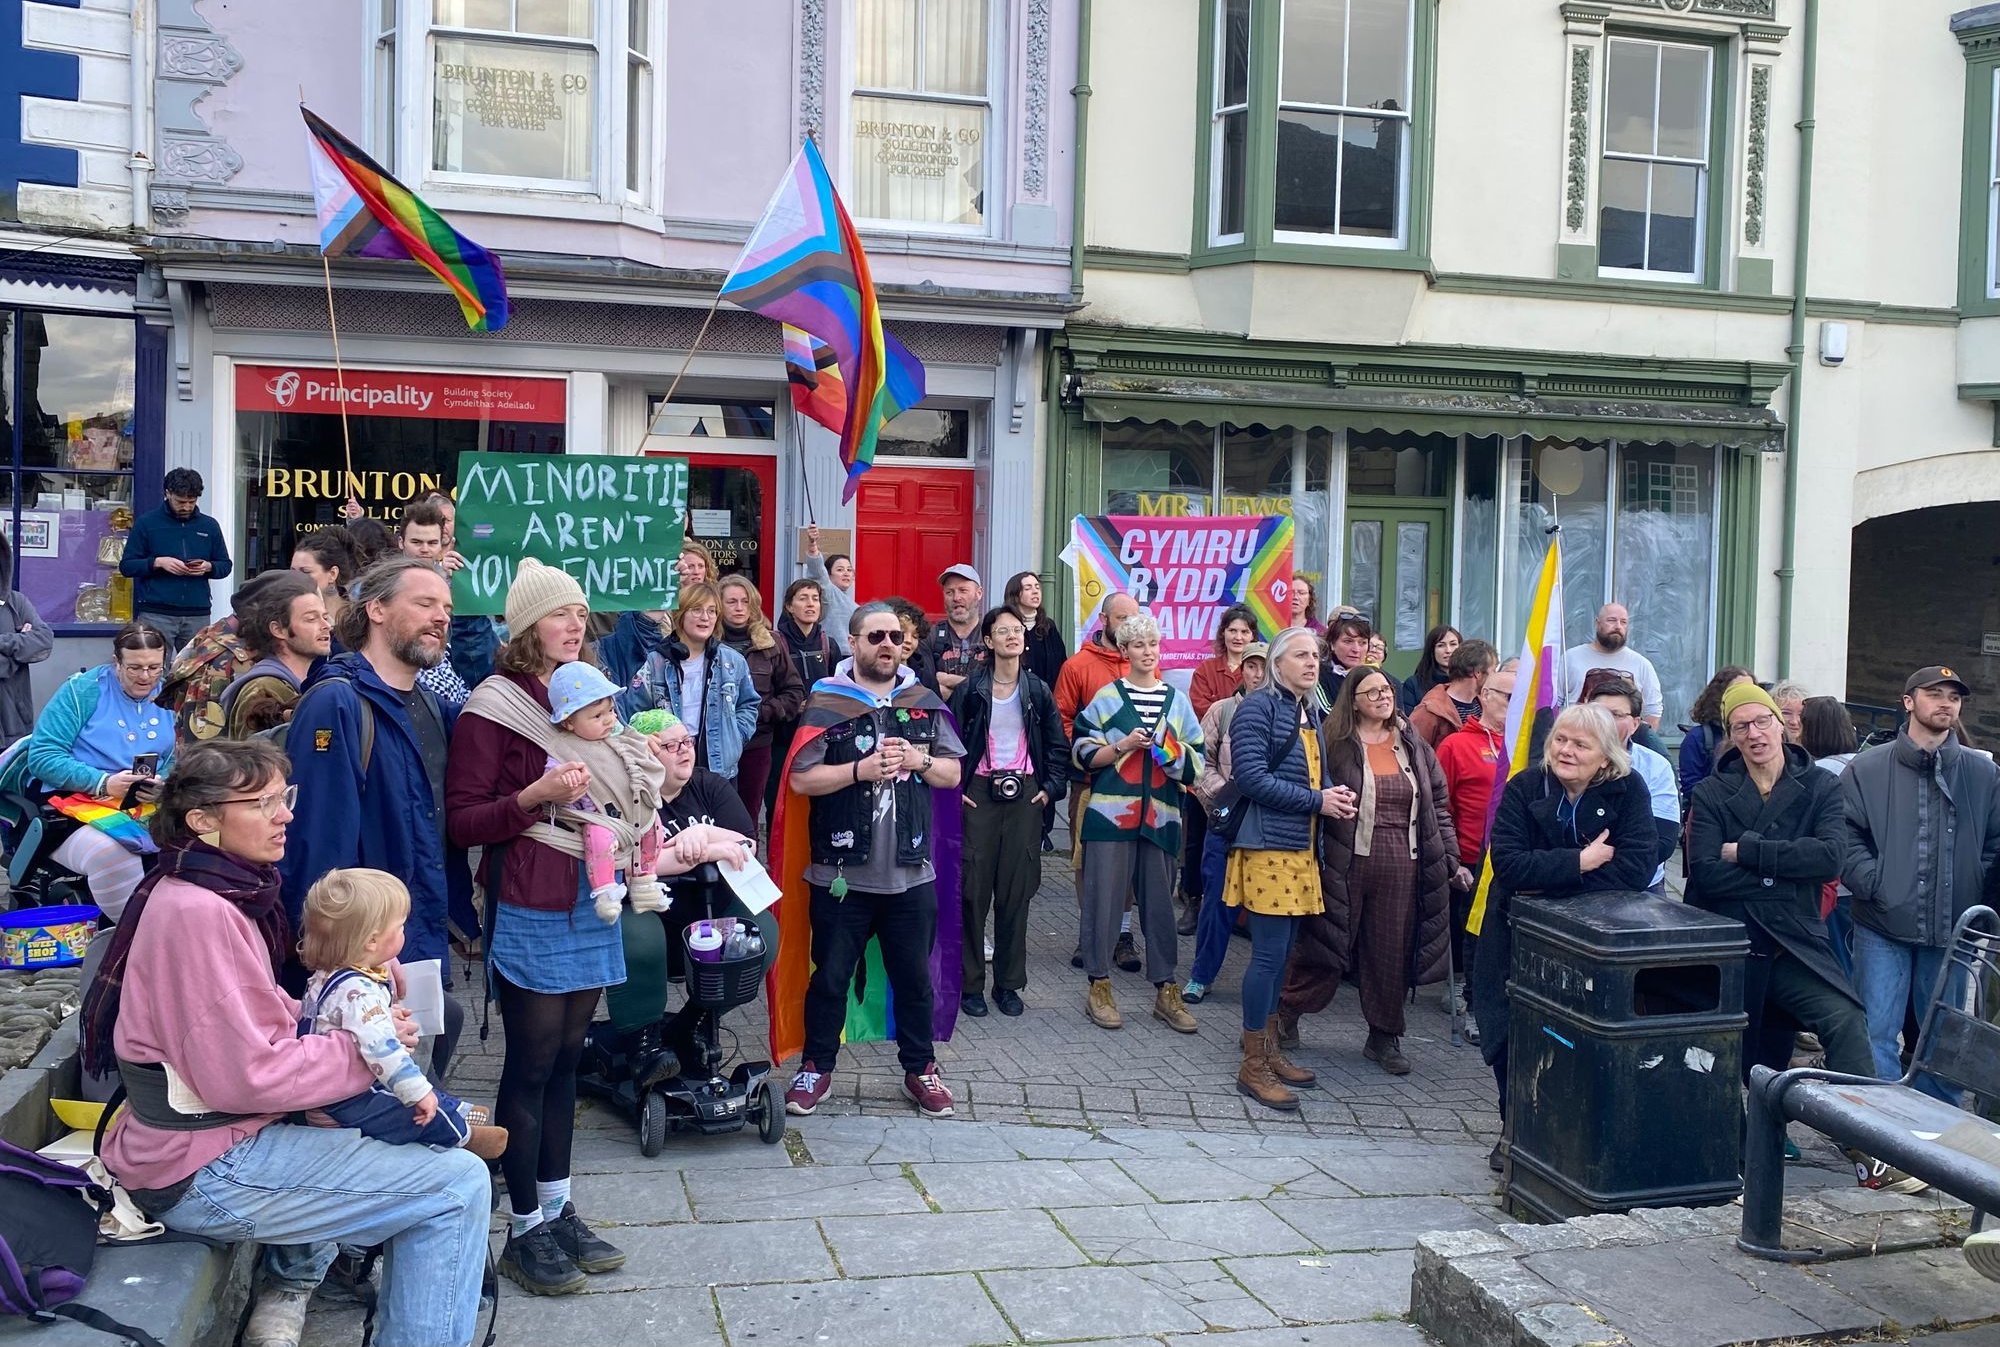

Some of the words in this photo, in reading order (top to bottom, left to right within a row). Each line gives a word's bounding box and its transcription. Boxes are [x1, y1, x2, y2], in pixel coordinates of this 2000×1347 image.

[442, 64, 534, 89] BRUNTON
[541, 72, 553, 89] &
[561, 74, 587, 93] CO
[857, 121, 935, 140] BRUNTON
[942, 127, 952, 141] &
[958, 128, 979, 144] CO
[885, 139, 952, 154] SOLICITORS
[877, 152, 959, 166] COMMISSIONERS
[890, 165, 909, 175] FOR
[914, 167, 945, 177] OATHS
[306, 381, 433, 411] Principality
[443, 387, 479, 399] Building
[481, 389, 513, 400] Society
[443, 398, 495, 409] Cymdeithas
[497, 401, 535, 410] Adeiladu
[267, 468, 441, 500] BRUNTON
[1137, 494, 1189, 516] MR
[521, 511, 653, 551] AREN'T
[727, 540, 736, 550] &
[740, 540, 758, 551] CO
[1119, 529, 1259, 565] CYMRU
[718, 558, 735, 566] FOR
[1128, 568, 1226, 602] RYDD
[1235, 568, 1251, 603] I
[28, 948, 57, 957] SHOP
